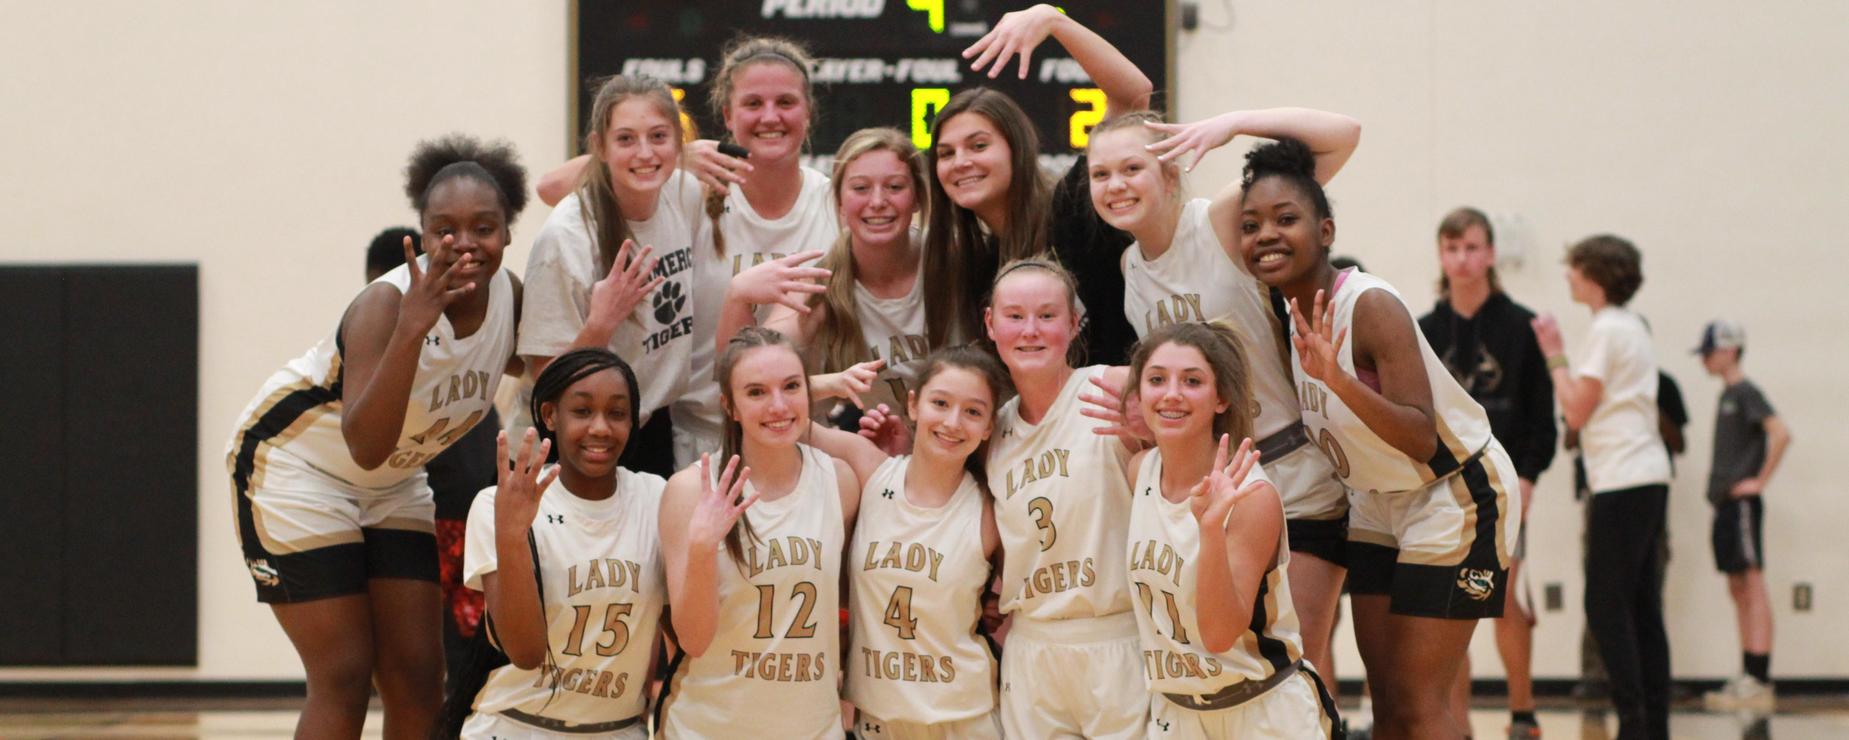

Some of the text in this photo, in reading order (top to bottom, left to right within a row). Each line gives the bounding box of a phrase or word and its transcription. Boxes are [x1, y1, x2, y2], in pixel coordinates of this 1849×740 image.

[1069, 88, 1108, 149] 2
[642, 316, 693, 354] TIGER
[870, 333, 929, 373] LAD
[428, 369, 490, 413] LADY
[1300, 381, 1329, 420] ADY
[1006, 448, 1070, 500] LADY
[1028, 496, 1057, 552] 3
[568, 558, 641, 597] LADY
[748, 536, 823, 578] LADY
[863, 541, 944, 582] LADY
[1023, 557, 1096, 599] IGERS
[1130, 539, 1185, 587] LADY
[562, 603, 633, 657] 15
[754, 581, 818, 639] 12
[883, 585, 918, 640] 4
[533, 664, 629, 699] TIGERS
[731, 649, 825, 683] TIGERS
[862, 646, 956, 684] TIGERS
